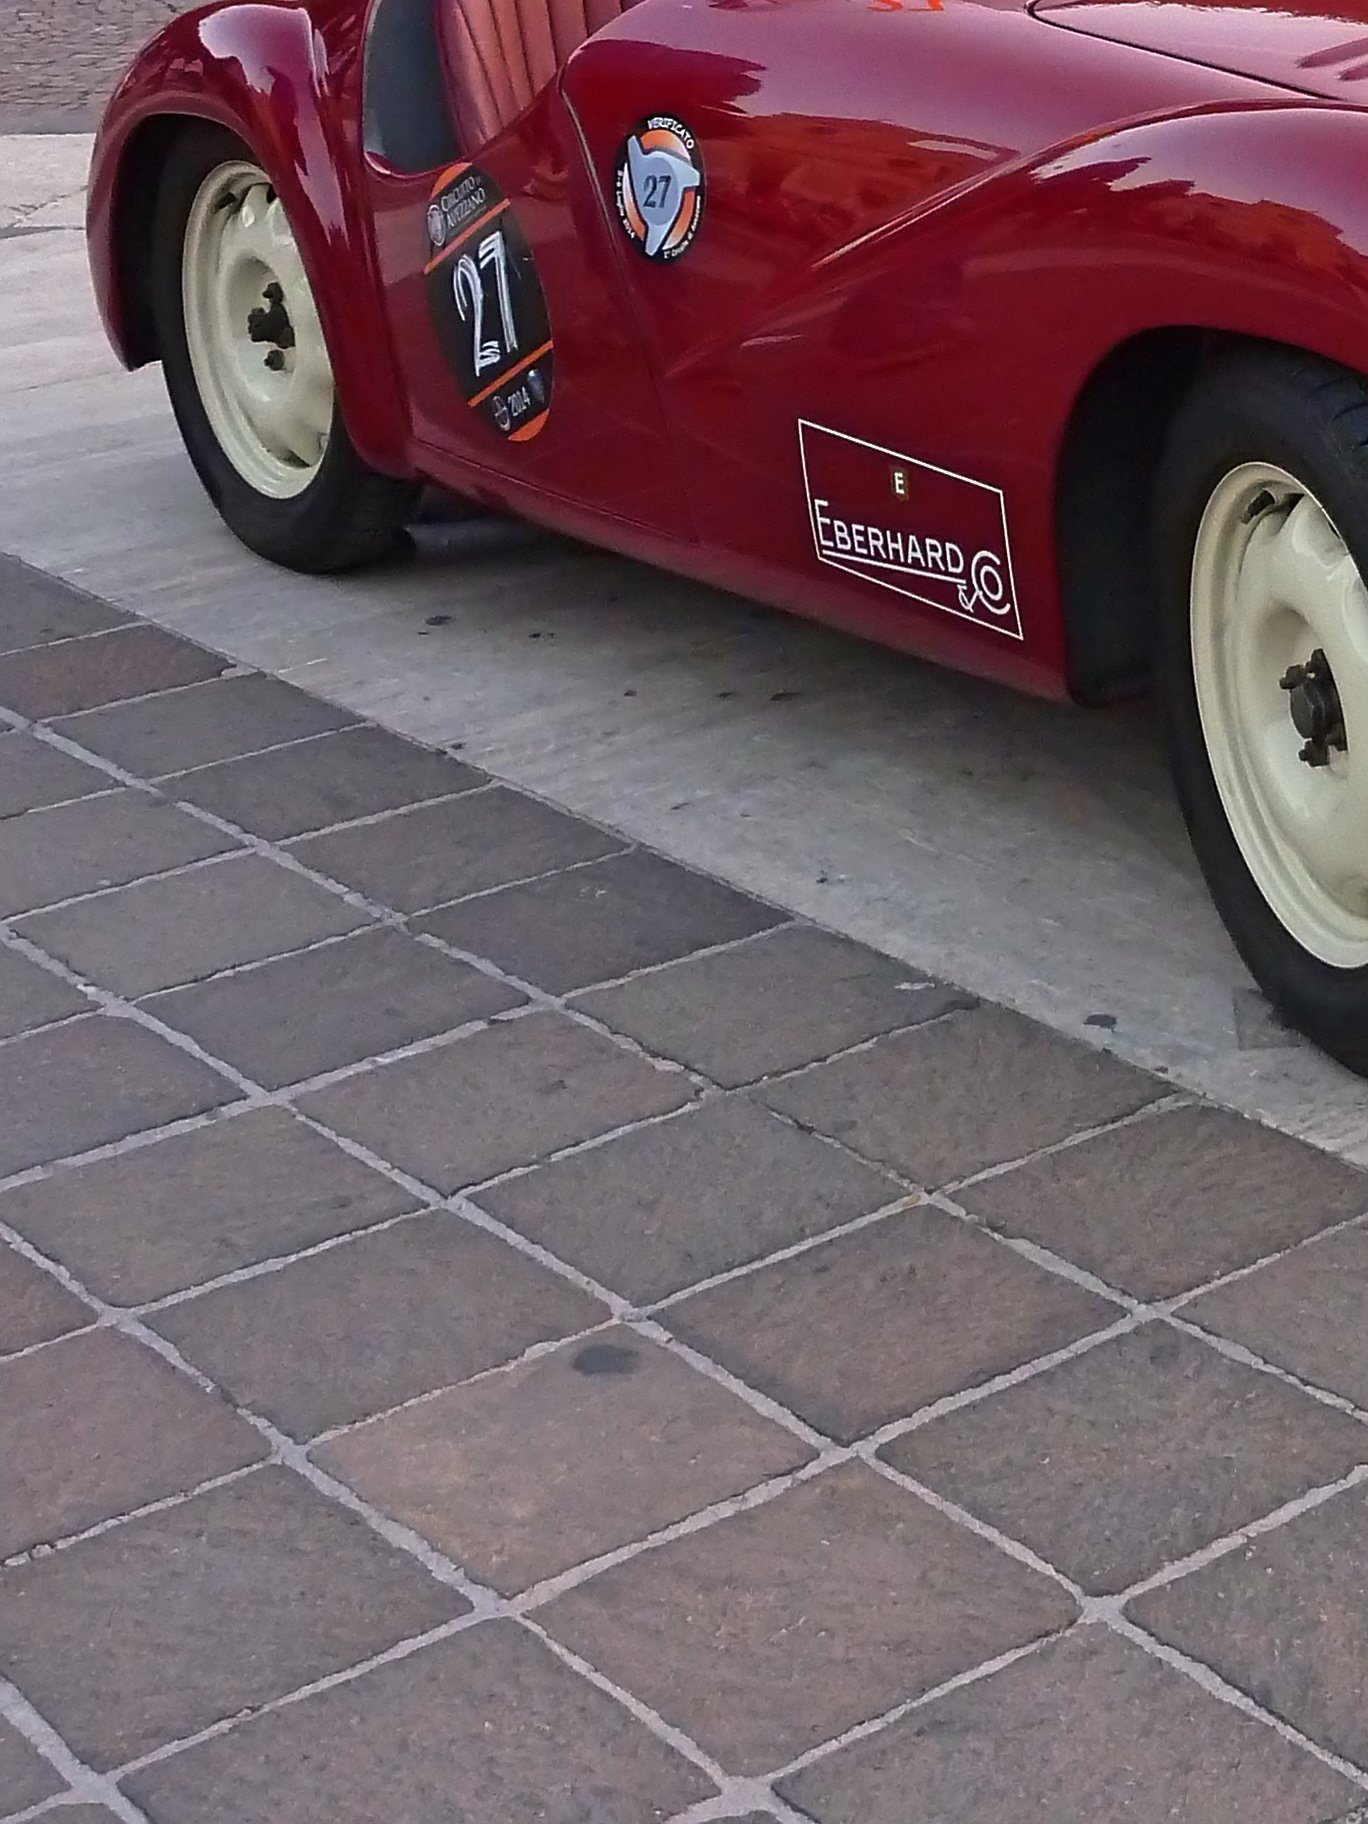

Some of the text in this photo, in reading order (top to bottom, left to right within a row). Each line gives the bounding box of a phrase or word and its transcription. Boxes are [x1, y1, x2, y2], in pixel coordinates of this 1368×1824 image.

[647, 117, 694, 149] VERIFICATO
[643, 174, 672, 209] 27
[453, 231, 518, 377] 27
[894, 472, 905, 495] E
